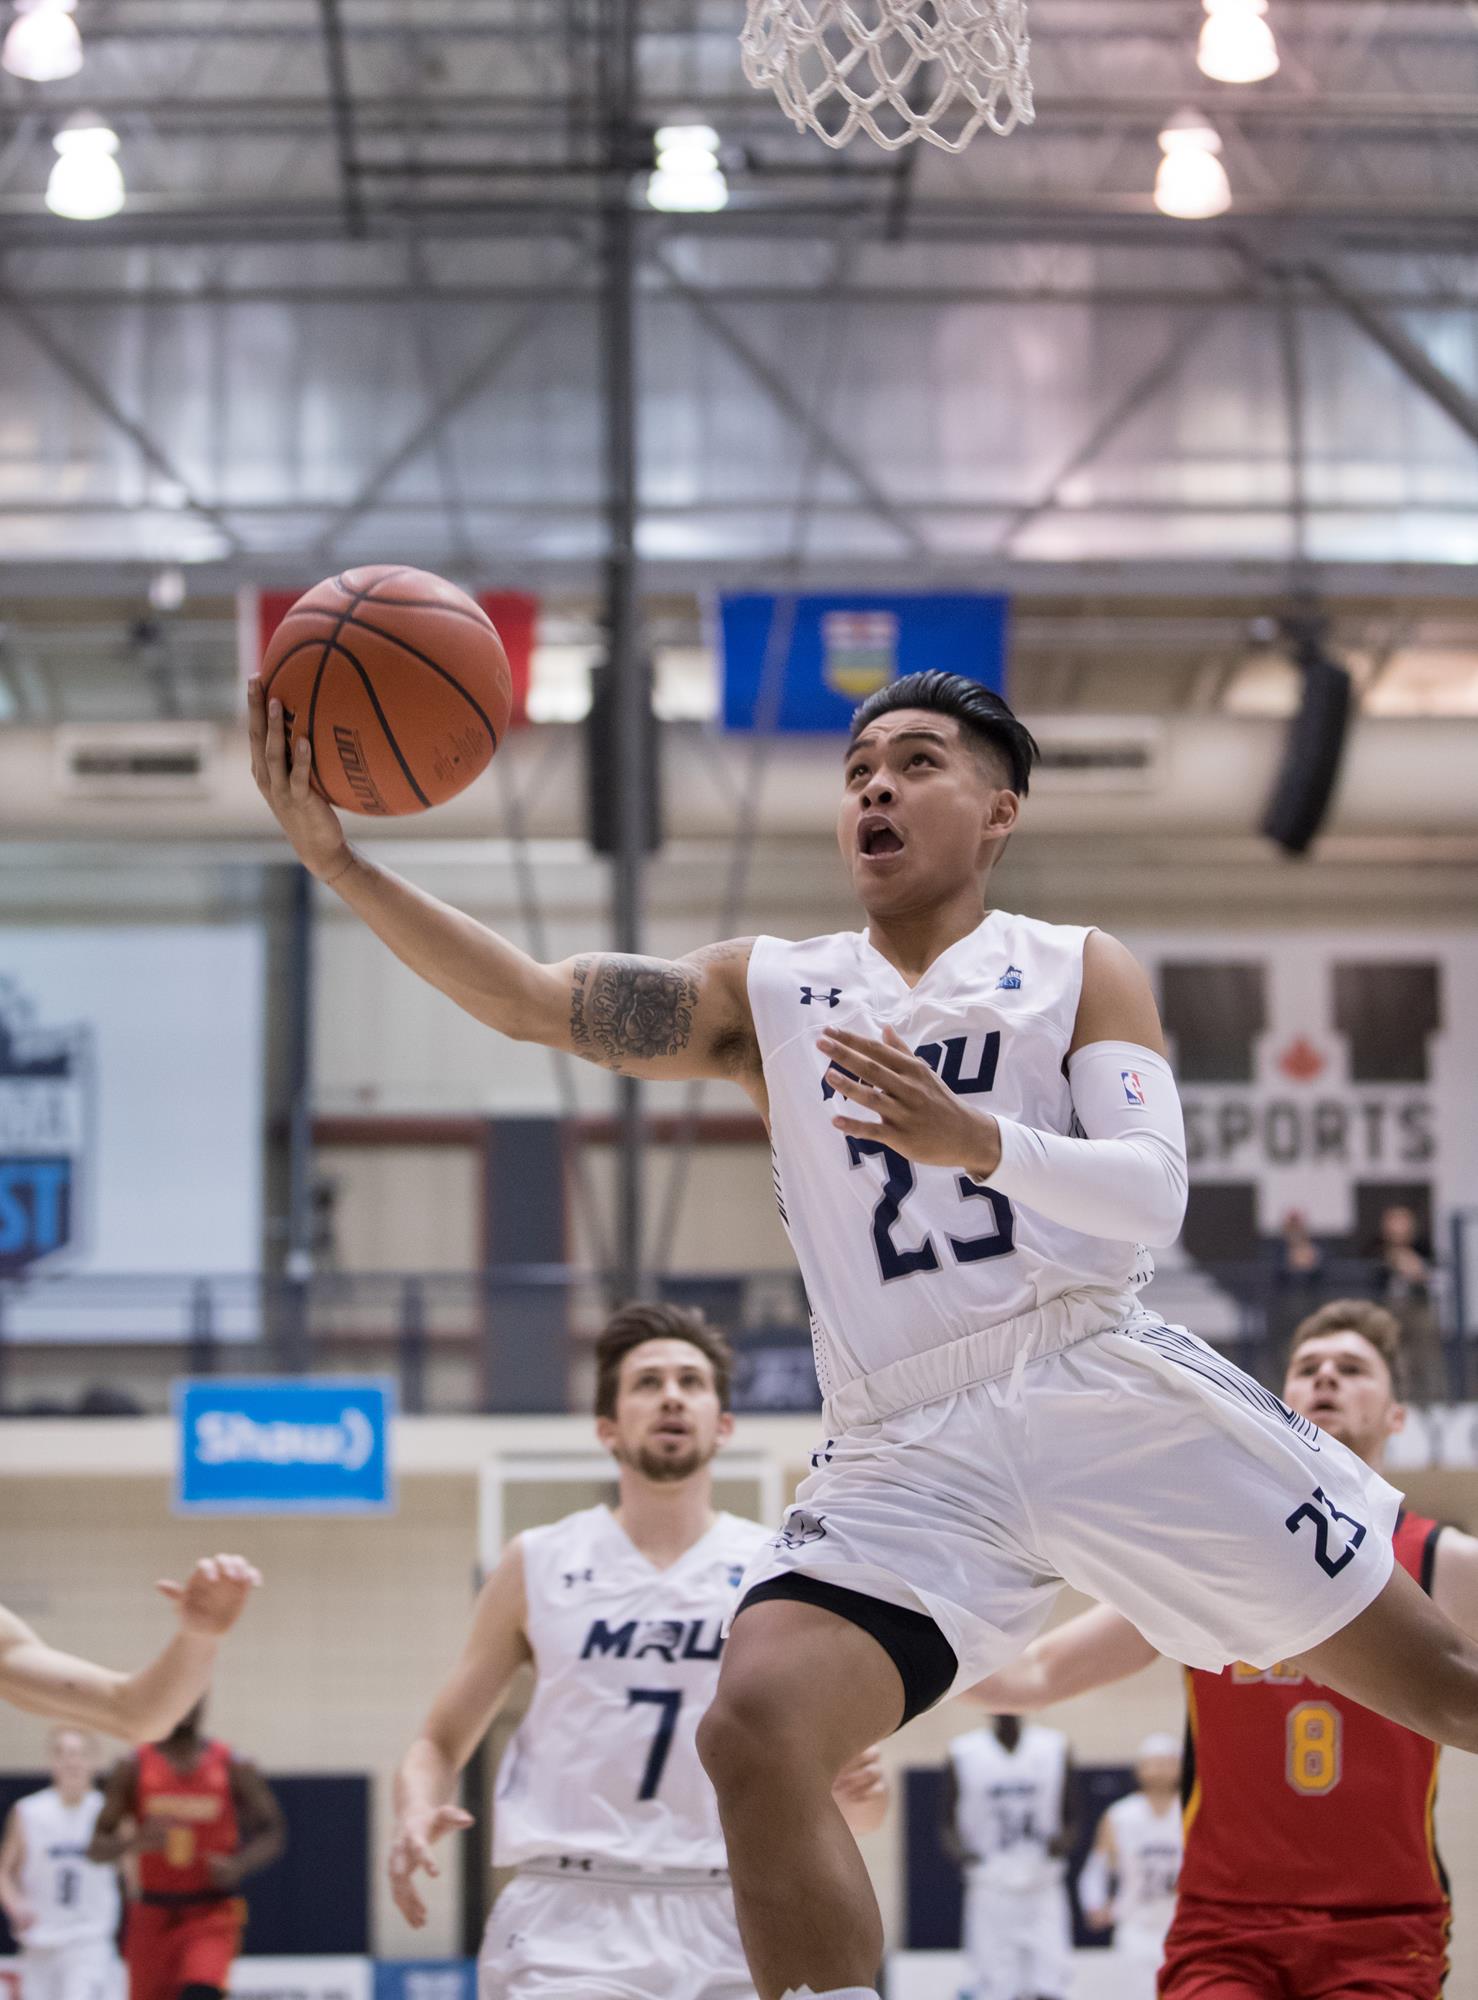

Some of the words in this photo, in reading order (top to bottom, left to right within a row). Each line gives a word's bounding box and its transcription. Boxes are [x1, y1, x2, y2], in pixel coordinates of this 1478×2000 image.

[1181, 1101, 1435, 1163] SPORTS
[0, 1162, 68, 1248] ST
[846, 1133, 1017, 1286] 23
[1285, 1486, 1367, 1578] 23
[580, 1618, 727, 1663] MRU
[625, 1686, 682, 1800] 7
[1285, 1700, 1342, 1797] 8
